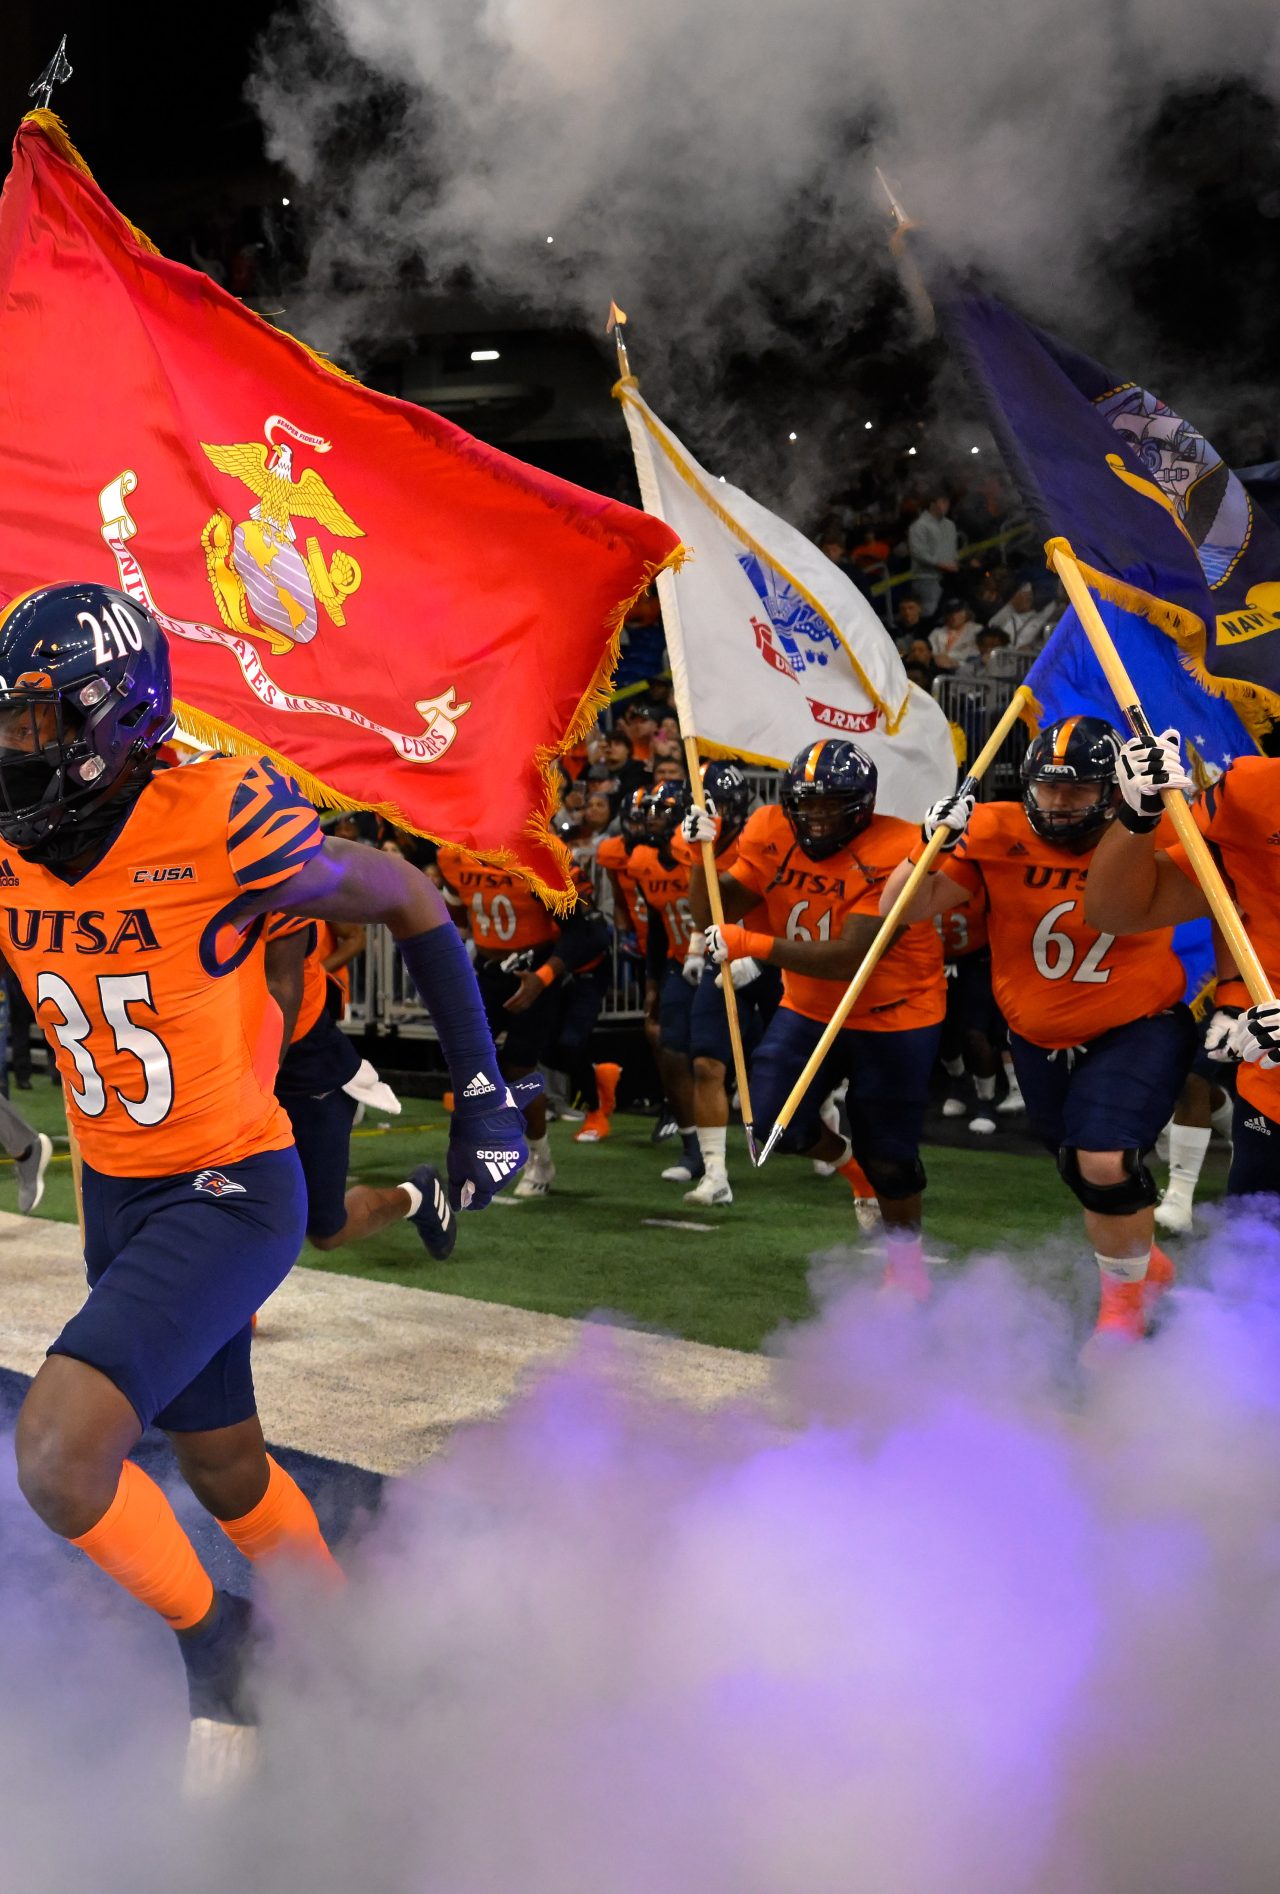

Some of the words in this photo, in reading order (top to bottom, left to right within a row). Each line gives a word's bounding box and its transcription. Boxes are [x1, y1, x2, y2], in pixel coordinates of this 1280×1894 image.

[276, 418, 299, 437] SEMPER
[298, 432, 323, 445] FIDELIS
[76, 602, 143, 667] 210
[194, 625, 278, 705] STATES
[283, 696, 384, 734] MARINE
[401, 728, 448, 758] CORPS
[816, 707, 870, 731] ARMY
[1044, 765, 1069, 774] UTSA
[459, 871, 513, 888] UTSA
[778, 867, 845, 898] UTSA
[1023, 865, 1089, 890] UTS
[4, 906, 162, 955] UTSA
[471, 891, 517, 942] 40
[785, 900, 832, 942] 61
[1032, 900, 1116, 983] 62
[36, 970, 175, 1128] 35
[462, 1083, 497, 1098] adidas
[1243, 1120, 1271, 1136] adidas
[476, 1150, 520, 1163] adidas
